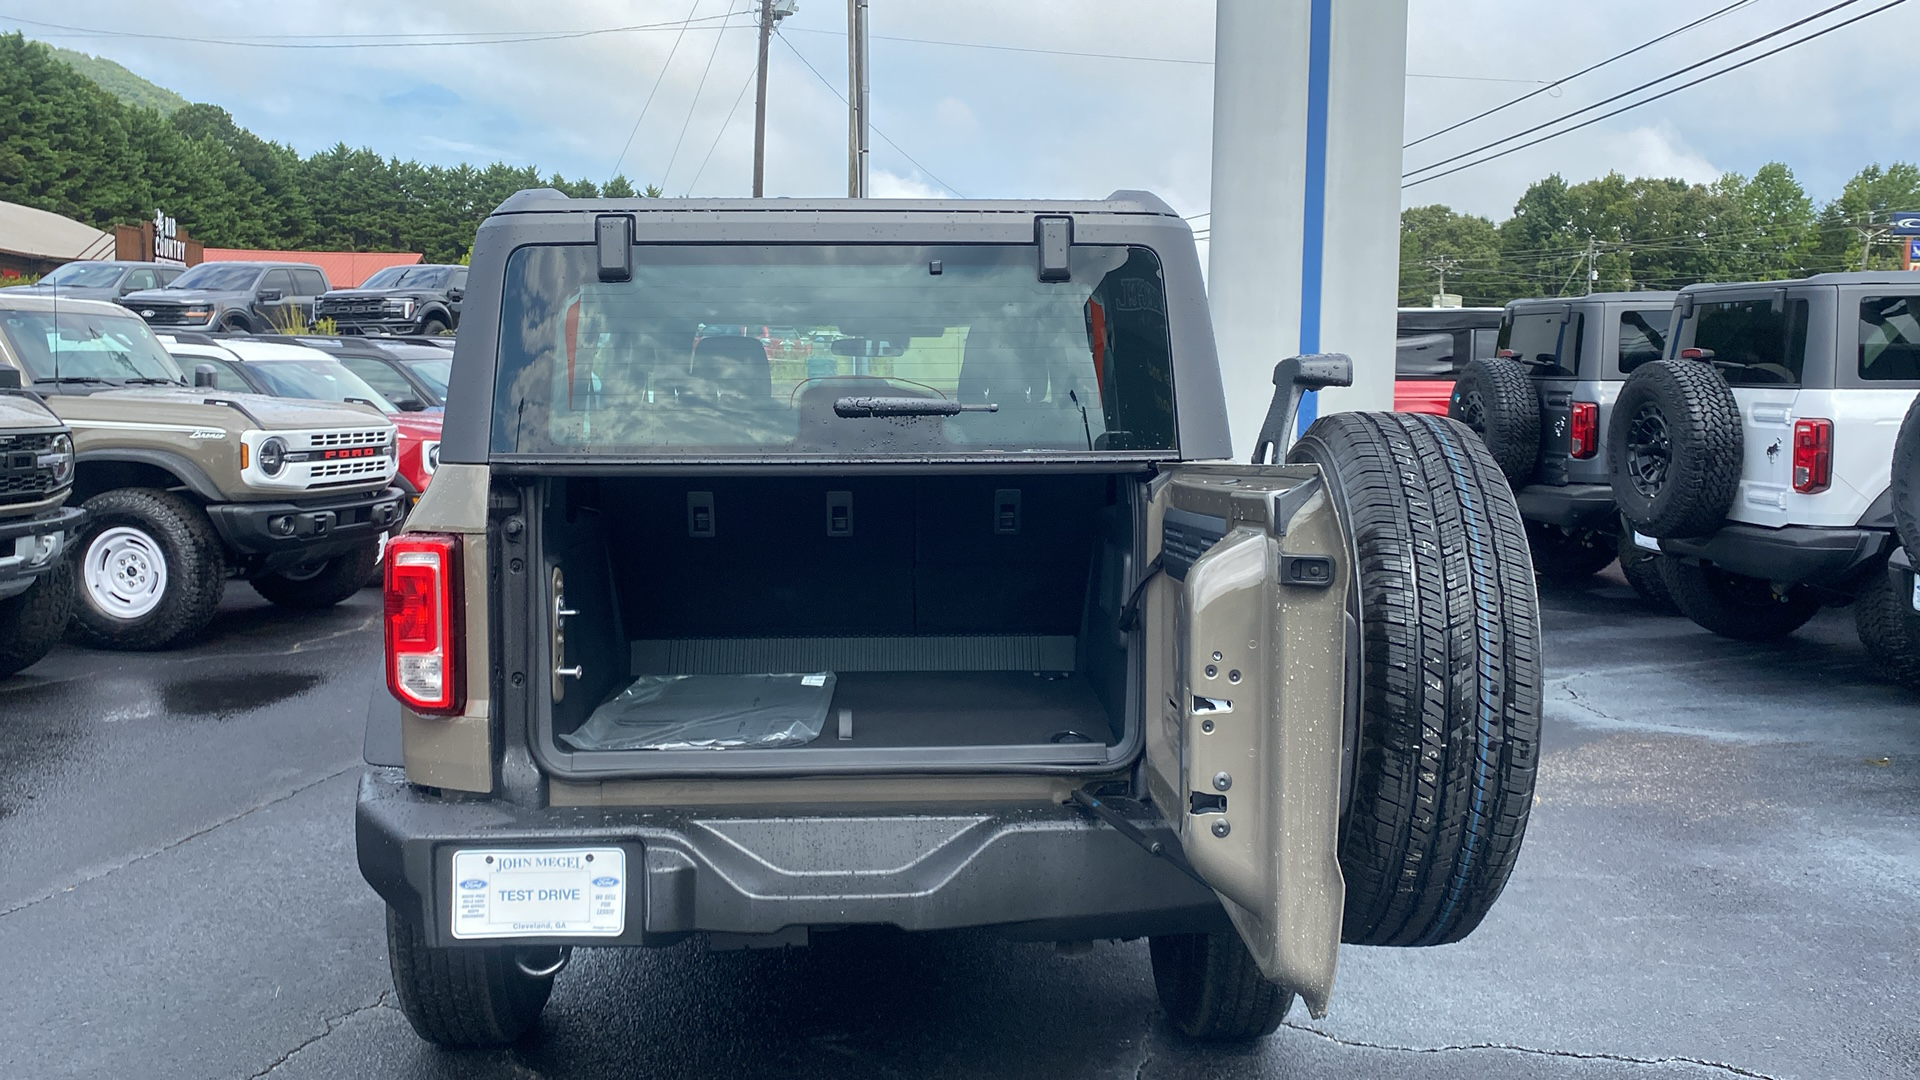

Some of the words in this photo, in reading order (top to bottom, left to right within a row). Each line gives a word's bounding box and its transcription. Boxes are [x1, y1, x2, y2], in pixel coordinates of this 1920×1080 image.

[165, 216, 177, 238] RIB
[155, 235, 186, 261] COUNTRY
[325, 448, 374, 459] FORD
[496, 857, 531, 872] JOHN
[535, 856, 584, 870] MEGEL
[499, 890, 534, 901] TEST
[538, 889, 580, 900] DRIVE
